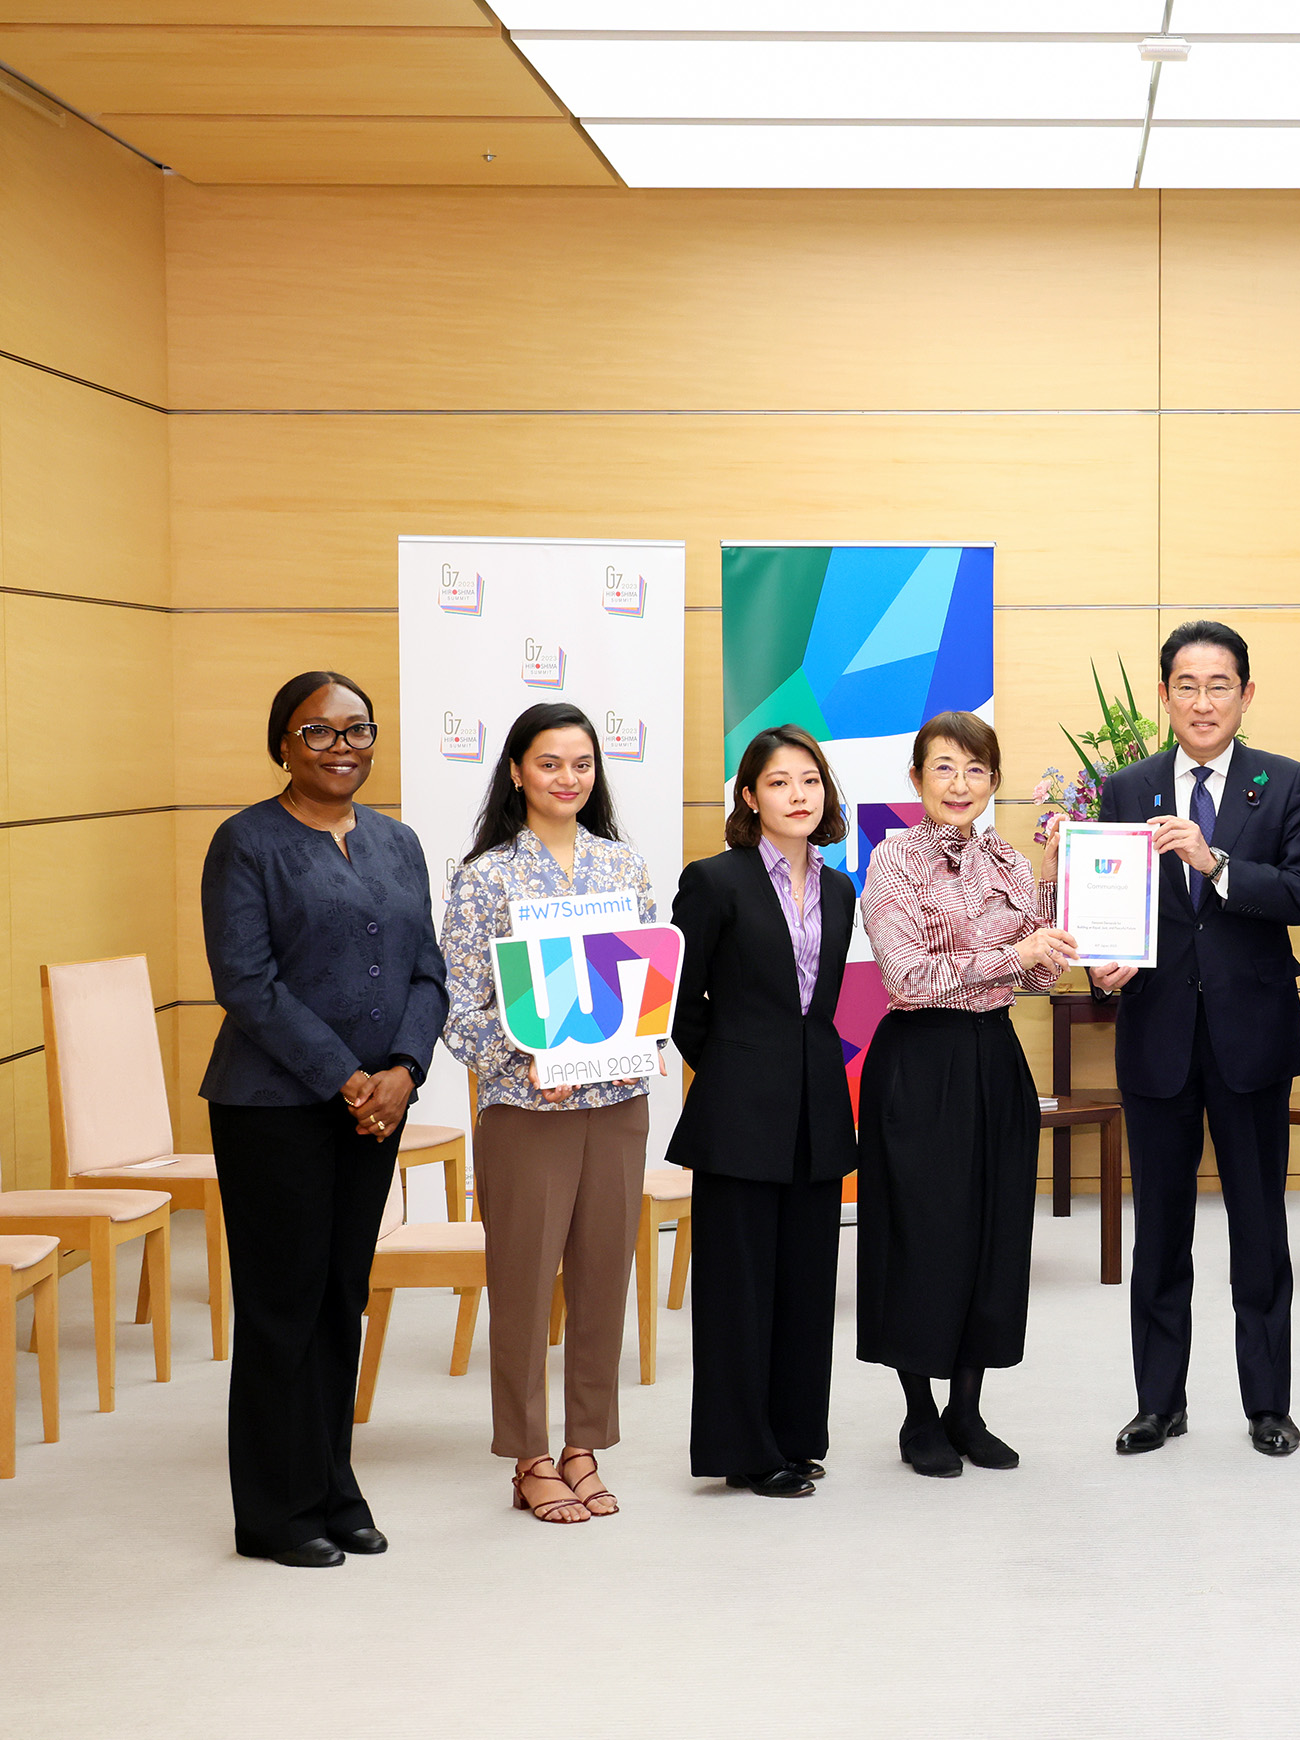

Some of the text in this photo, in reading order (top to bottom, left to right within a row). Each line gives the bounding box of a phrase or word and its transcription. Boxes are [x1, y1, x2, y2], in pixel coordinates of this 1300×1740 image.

[442, 563, 460, 588] G7
[606, 566, 623, 590] G7
[525, 637, 542, 662] G7
[444, 710, 462, 735] G7
[606, 710, 623, 734] G7
[1095, 859, 1122, 874] W7
[518, 896, 633, 922] #W7Summit
[496, 927, 680, 1050] W7
[543, 1053, 655, 1085] JAPAN 2023
